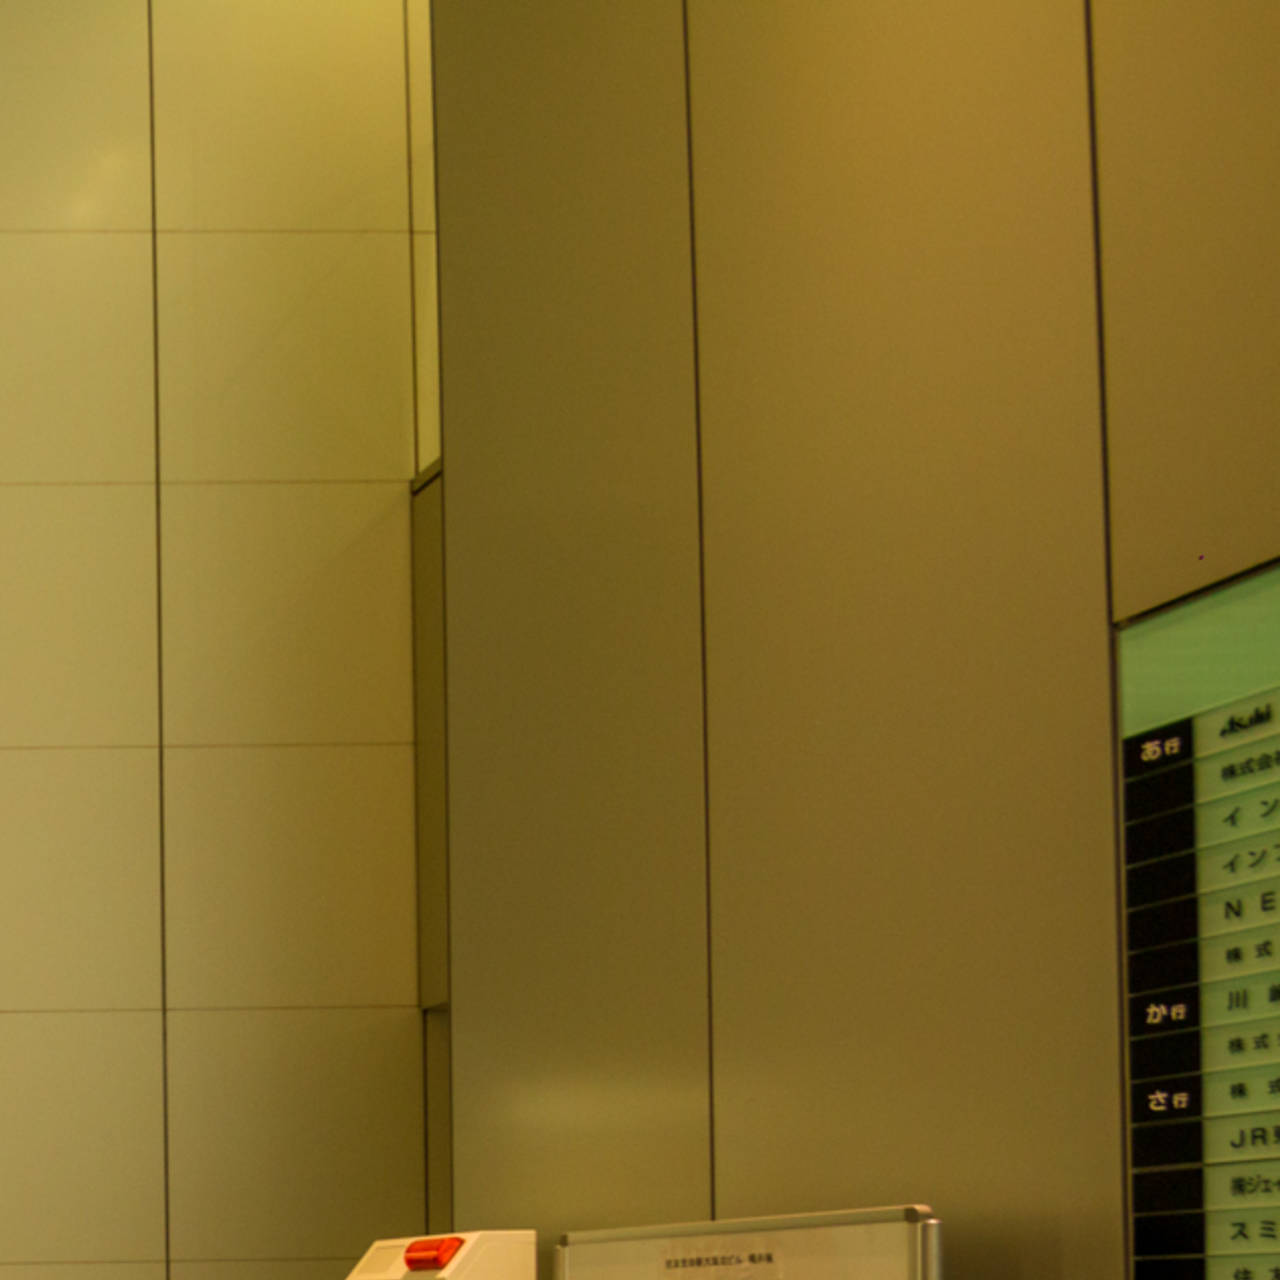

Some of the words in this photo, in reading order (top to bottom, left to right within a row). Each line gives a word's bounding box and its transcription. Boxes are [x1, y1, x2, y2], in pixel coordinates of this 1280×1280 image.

[1140, 737, 1182, 762] あ行
[1145, 1003, 1188, 1025] か行
[1228, 1033, 1280, 1055] 株式
[1147, 1090, 1189, 1112] さ行
